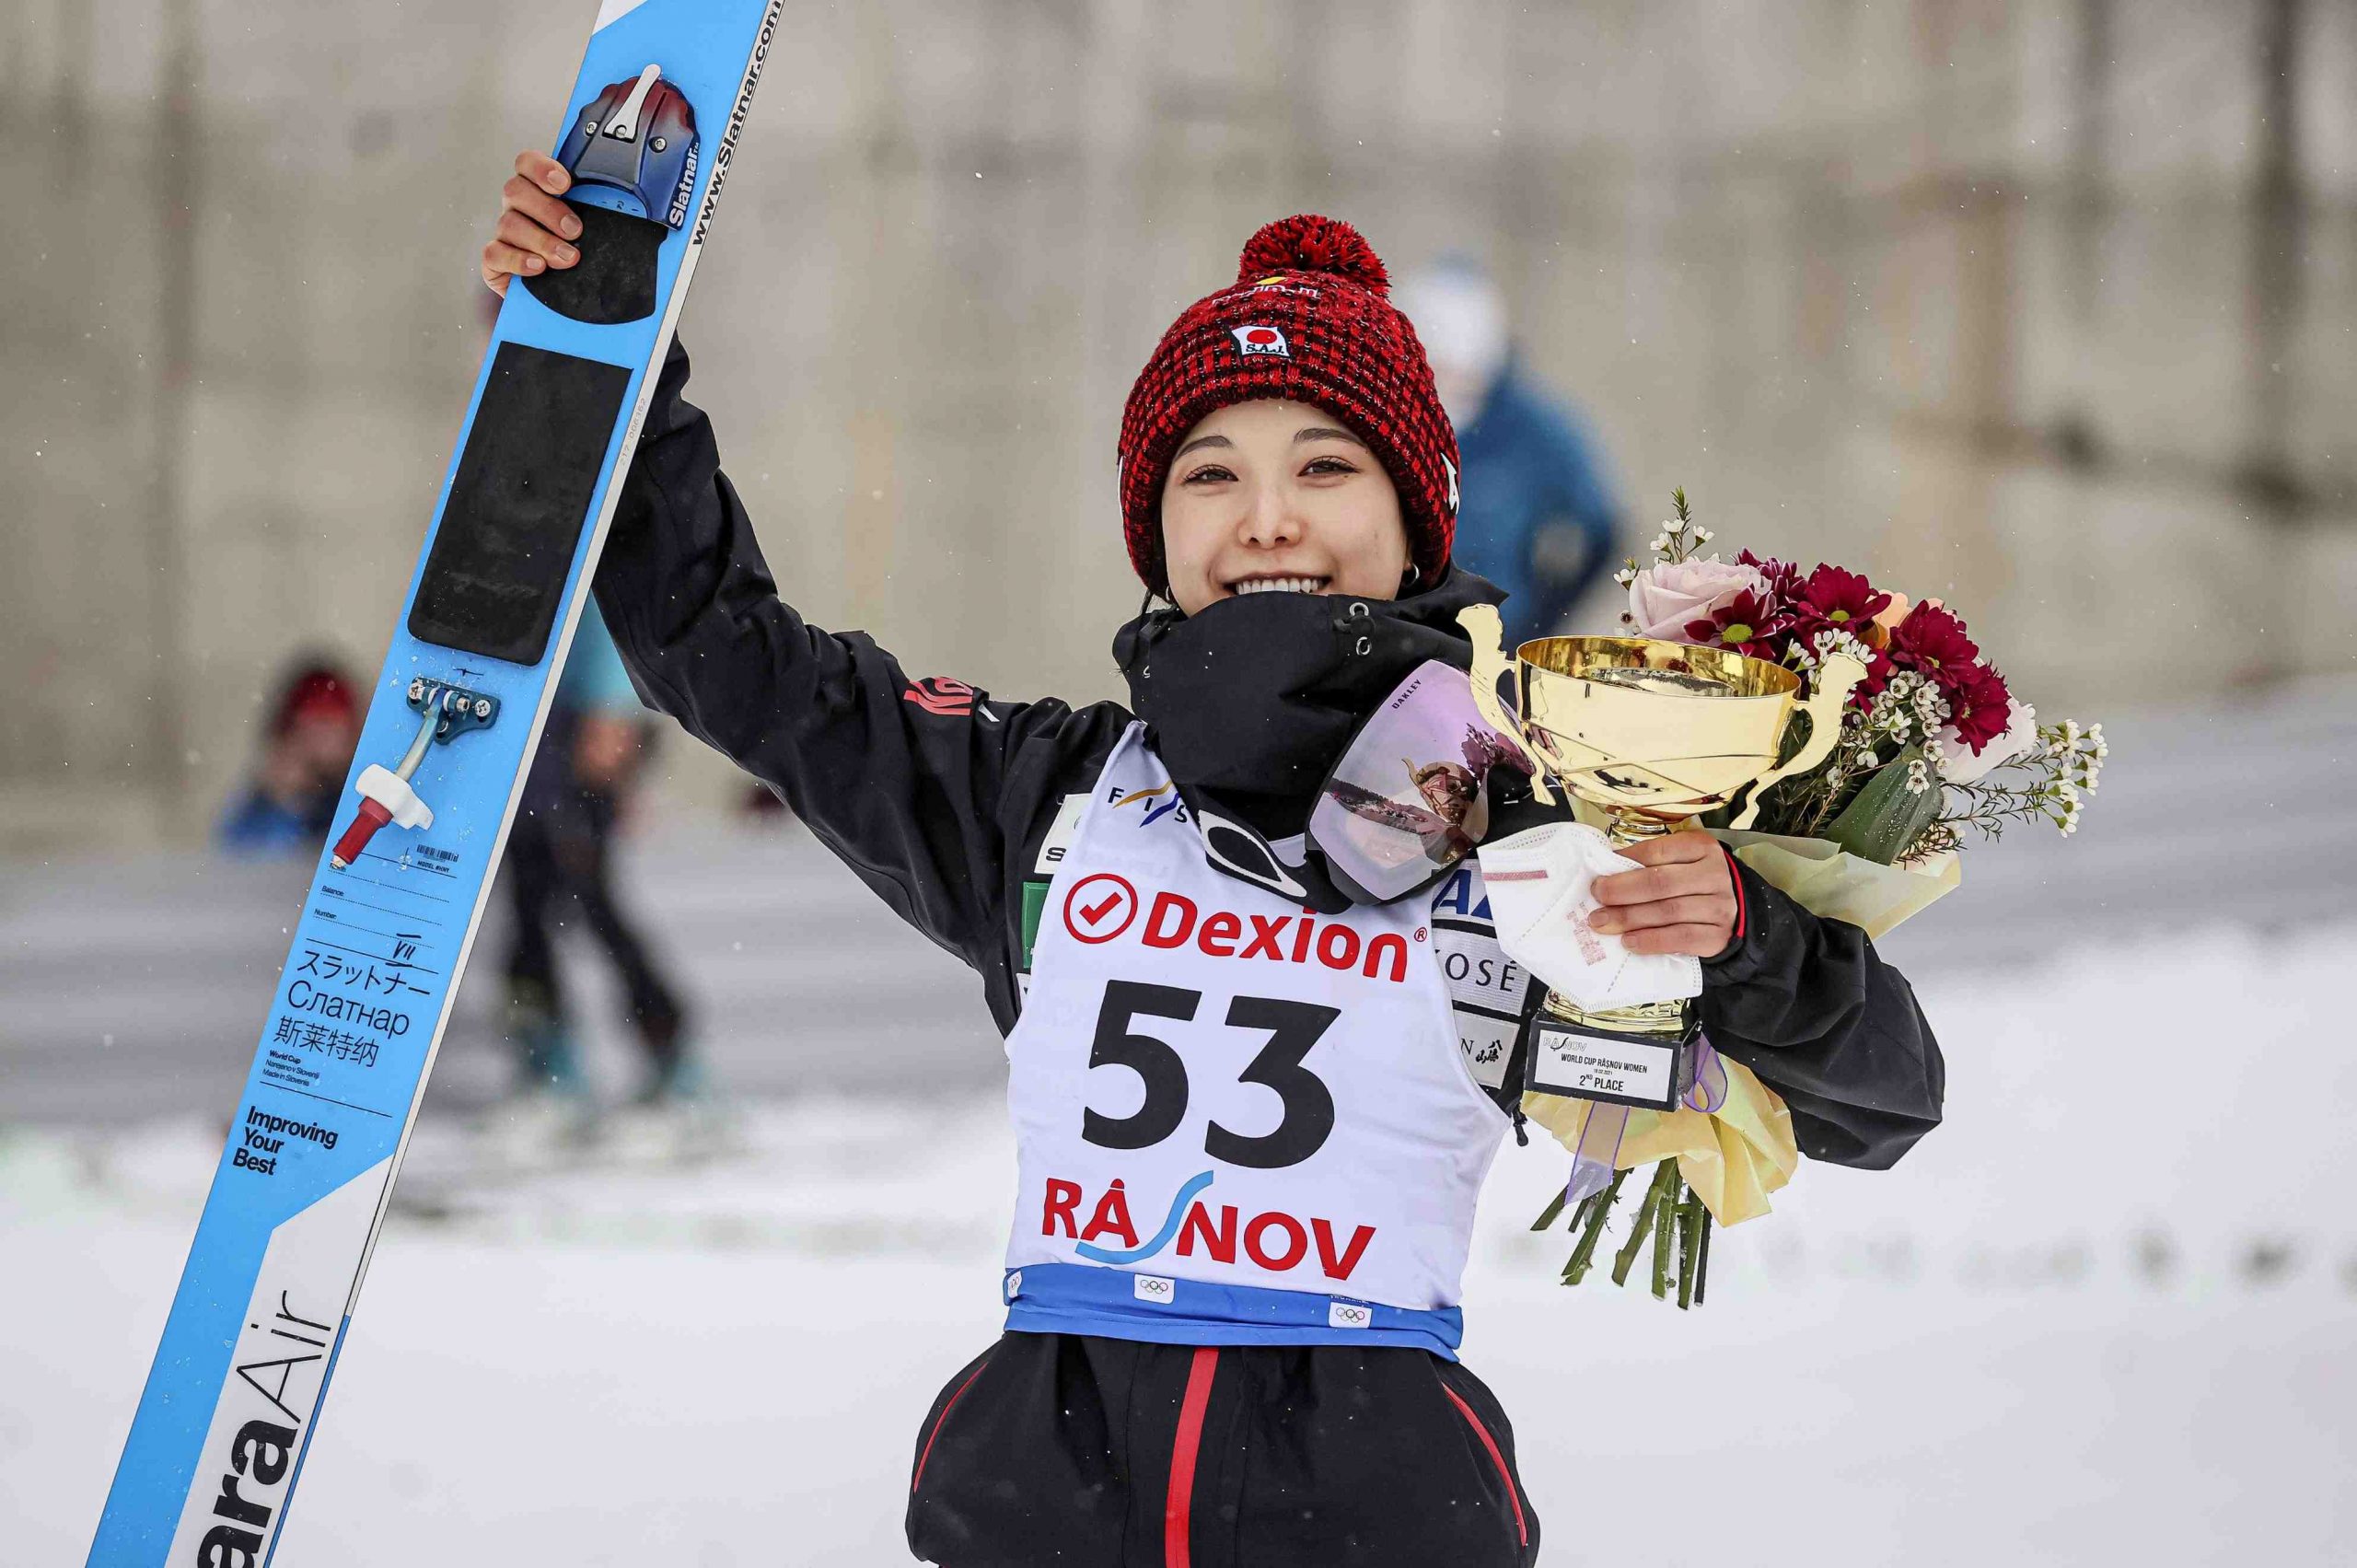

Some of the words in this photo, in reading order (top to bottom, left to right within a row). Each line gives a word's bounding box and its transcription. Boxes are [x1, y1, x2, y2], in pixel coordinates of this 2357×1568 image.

[692, 0, 782, 246] www.Slatnar.com
[1246, 343, 1284, 354] S.A.J.
[1391, 678, 1422, 710] OAKLEY
[296, 949, 431, 995] スラットナー
[1435, 949, 1518, 993] OSÉ
[287, 980, 410, 1040] Слатнар
[269, 1050, 289, 1061] World
[288, 1054, 302, 1064] Cup
[273, 1015, 380, 1068] 斯莱特纳
[1082, 979, 1342, 1168] 53
[1561, 1052, 1583, 1064] WORLD
[1584, 1056, 1596, 1066] CUP
[1623, 1062, 1648, 1074] WOMEN
[1594, 1077, 1624, 1092] PLACE
[244, 1126, 284, 1155] Your
[246, 1106, 339, 1150] Improving
[232, 1147, 277, 1176] Best
